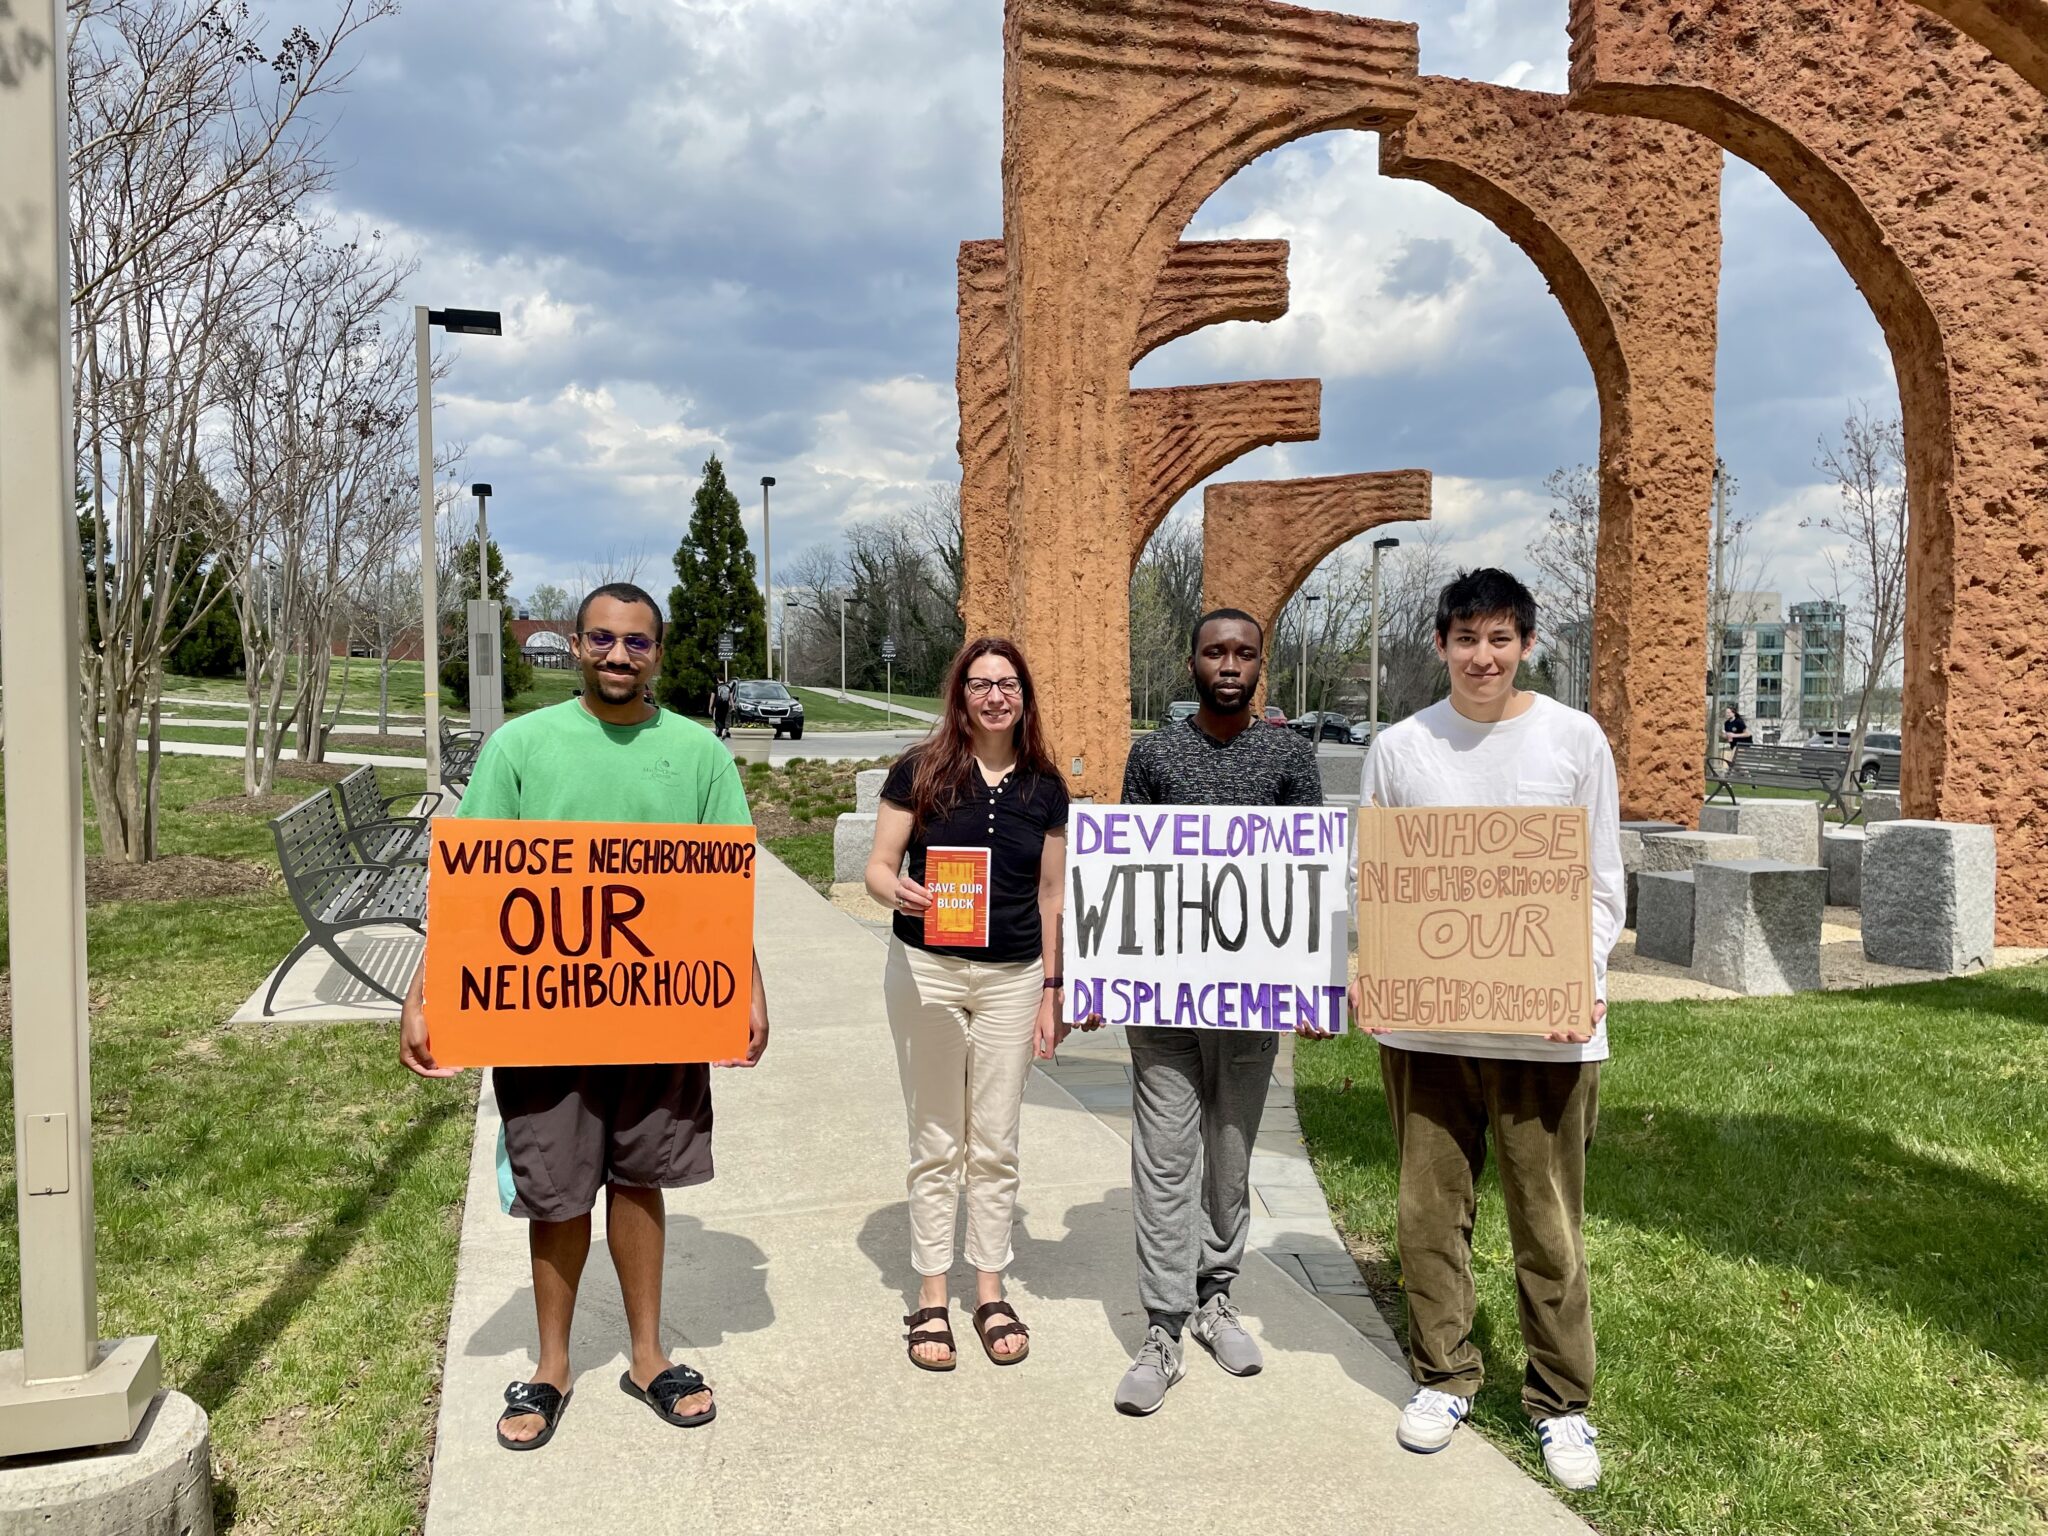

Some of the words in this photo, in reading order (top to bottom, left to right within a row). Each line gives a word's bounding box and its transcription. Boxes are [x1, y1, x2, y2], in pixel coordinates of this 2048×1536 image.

[438, 839, 573, 875] WHOSE
[588, 838, 756, 879] NEIGHBORHOOD?
[1076, 811, 1348, 858] DEVELOPMENT
[1394, 811, 1580, 860] WHOSE
[928, 882, 956, 893] SAVE
[960, 883, 983, 894] OUR
[937, 898, 974, 909] BLOCK
[1361, 861, 1589, 904] NEIGHBORHOOD?
[500, 884, 655, 959] OUR
[1071, 862, 1329, 959] WITHOUT
[1418, 904, 1555, 960] OUR
[460, 960, 736, 1011] NEIGHBORHOOD
[1073, 978, 1346, 1032] DISPLACEMENT
[1359, 974, 1583, 1026] NEIGHBORHOOD!
